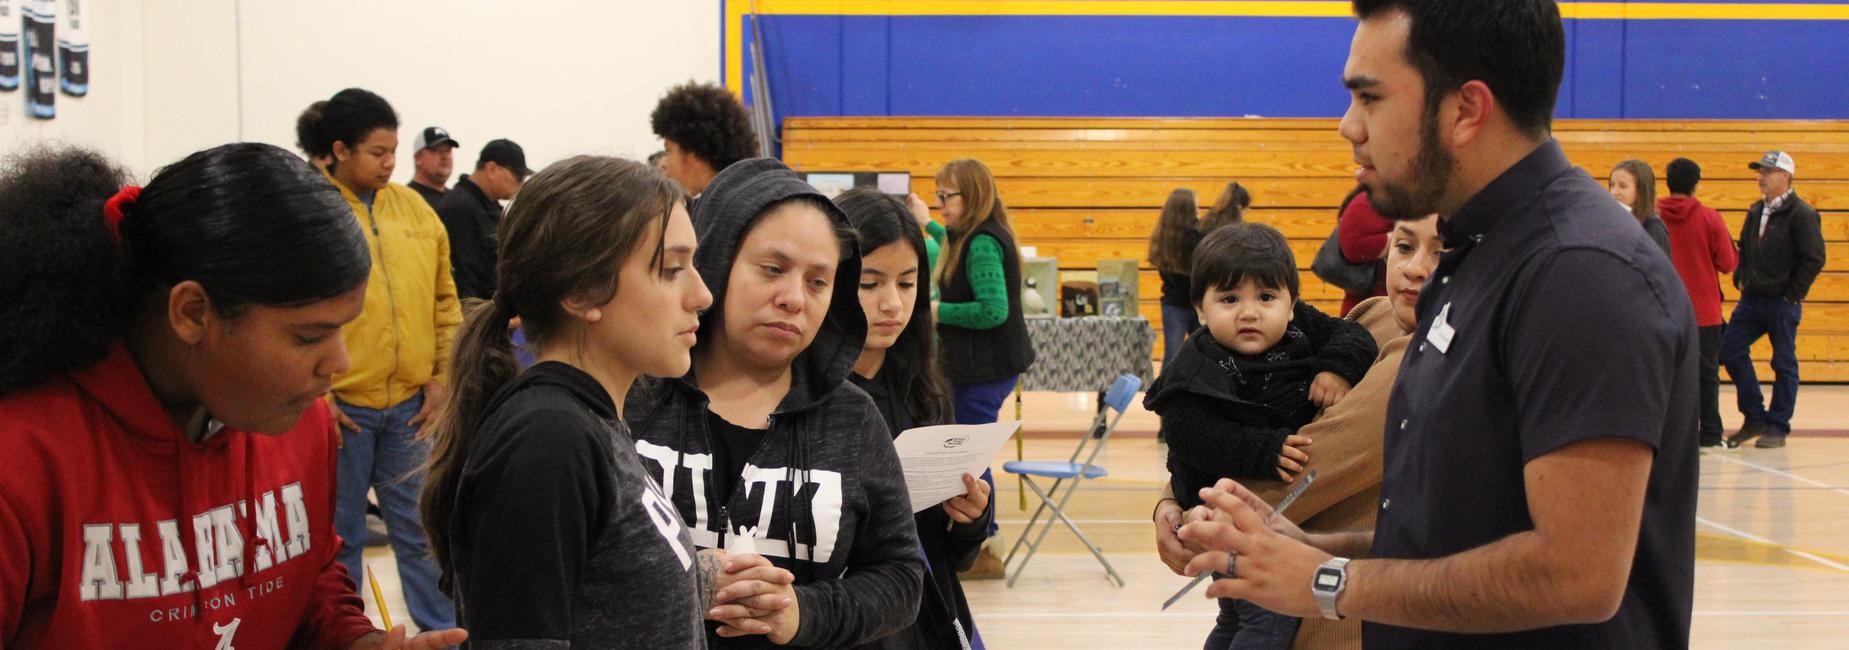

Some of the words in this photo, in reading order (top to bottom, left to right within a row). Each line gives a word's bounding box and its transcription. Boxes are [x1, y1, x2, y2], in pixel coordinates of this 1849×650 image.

[80, 481, 311, 601] ALABAMA
[150, 593, 236, 622] CRION
[247, 576, 285, 599] TIDE
